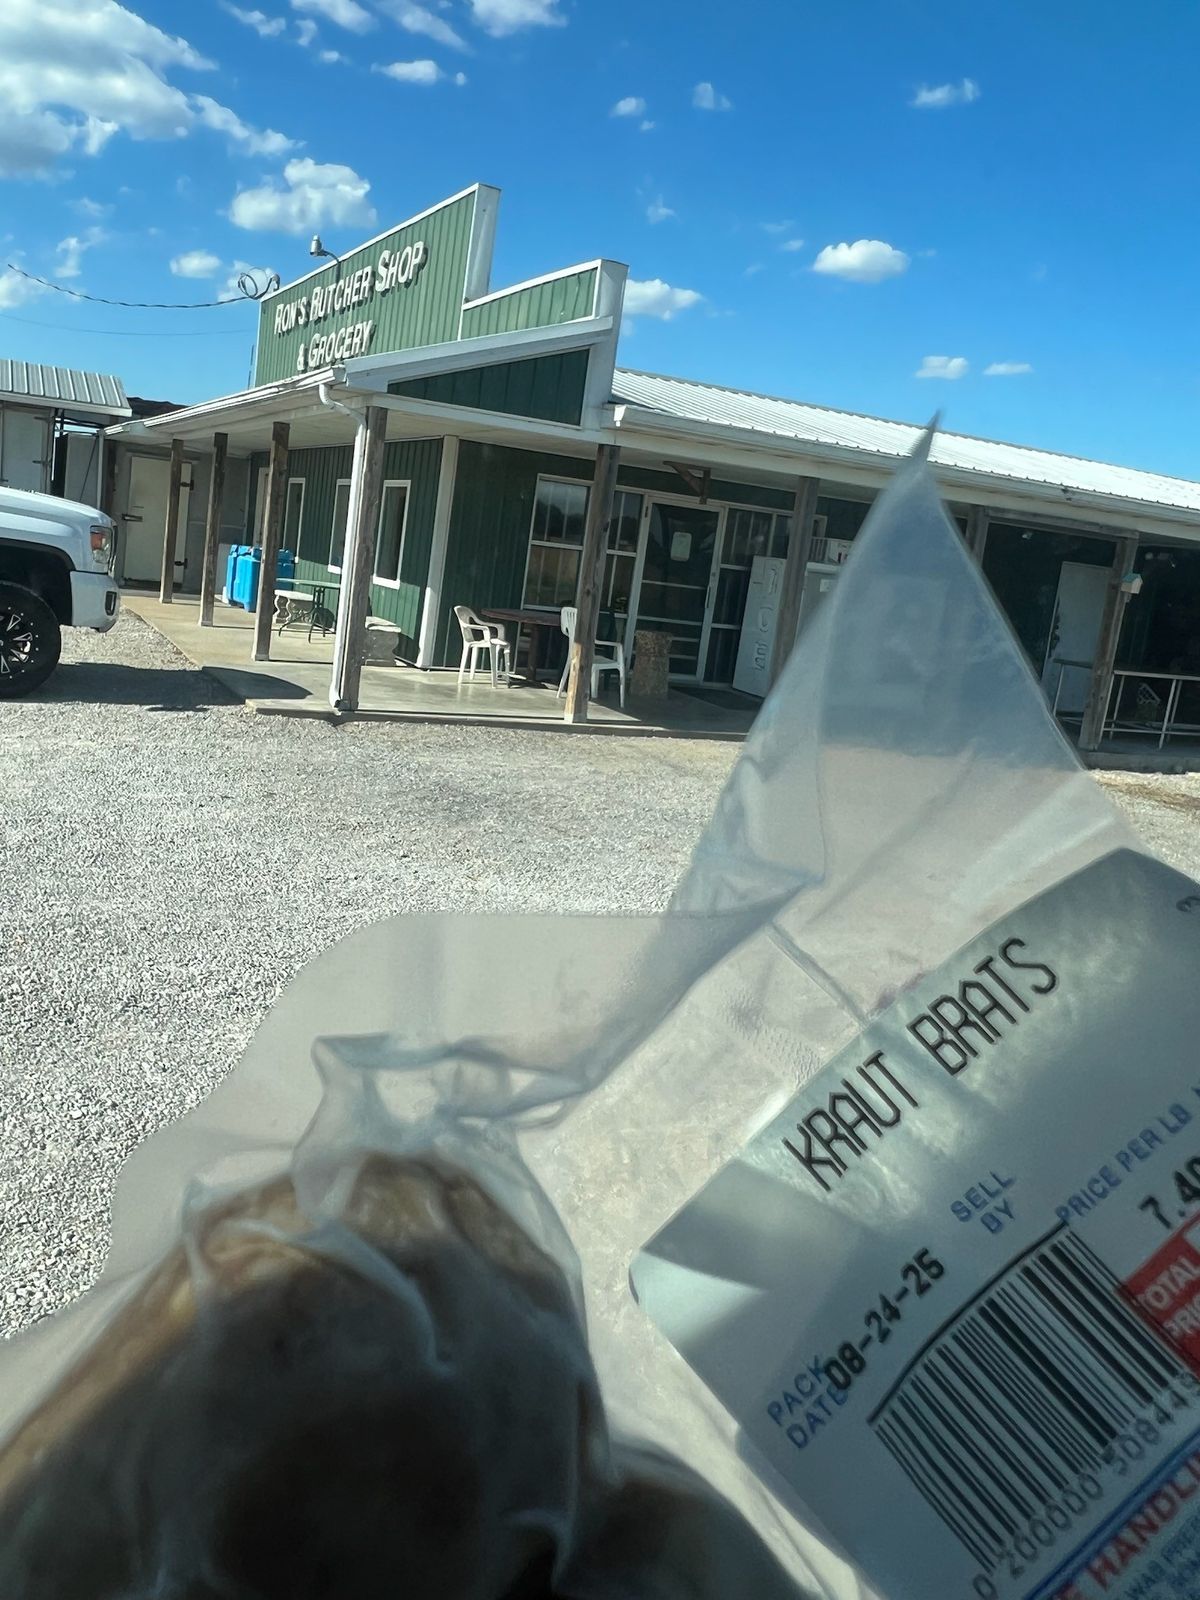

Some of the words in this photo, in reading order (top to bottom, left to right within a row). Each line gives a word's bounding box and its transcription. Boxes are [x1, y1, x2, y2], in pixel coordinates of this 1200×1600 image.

[273, 296, 307, 335] RON'S
[309, 265, 373, 322] BUTCHER
[375, 240, 425, 292] SHOP
[296, 343, 306, 371] &
[308, 319, 374, 368] GROCERY
[781, 1049, 919, 1192] KRAUT
[905, 937, 1057, 1077] BRATS
[950, 1169, 1016, 1223] SELL
[1055, 1164, 1122, 1221] PRICE
[1114, 1128, 1165, 1173] PER
[1156, 1102, 1193, 1134] LB
[980, 1198, 1015, 1235] BY
[823, 1247, 945, 1391] 08-24-25
[767, 1354, 826, 1428] PACK
[996, 1471, 1104, 1580] 200000
